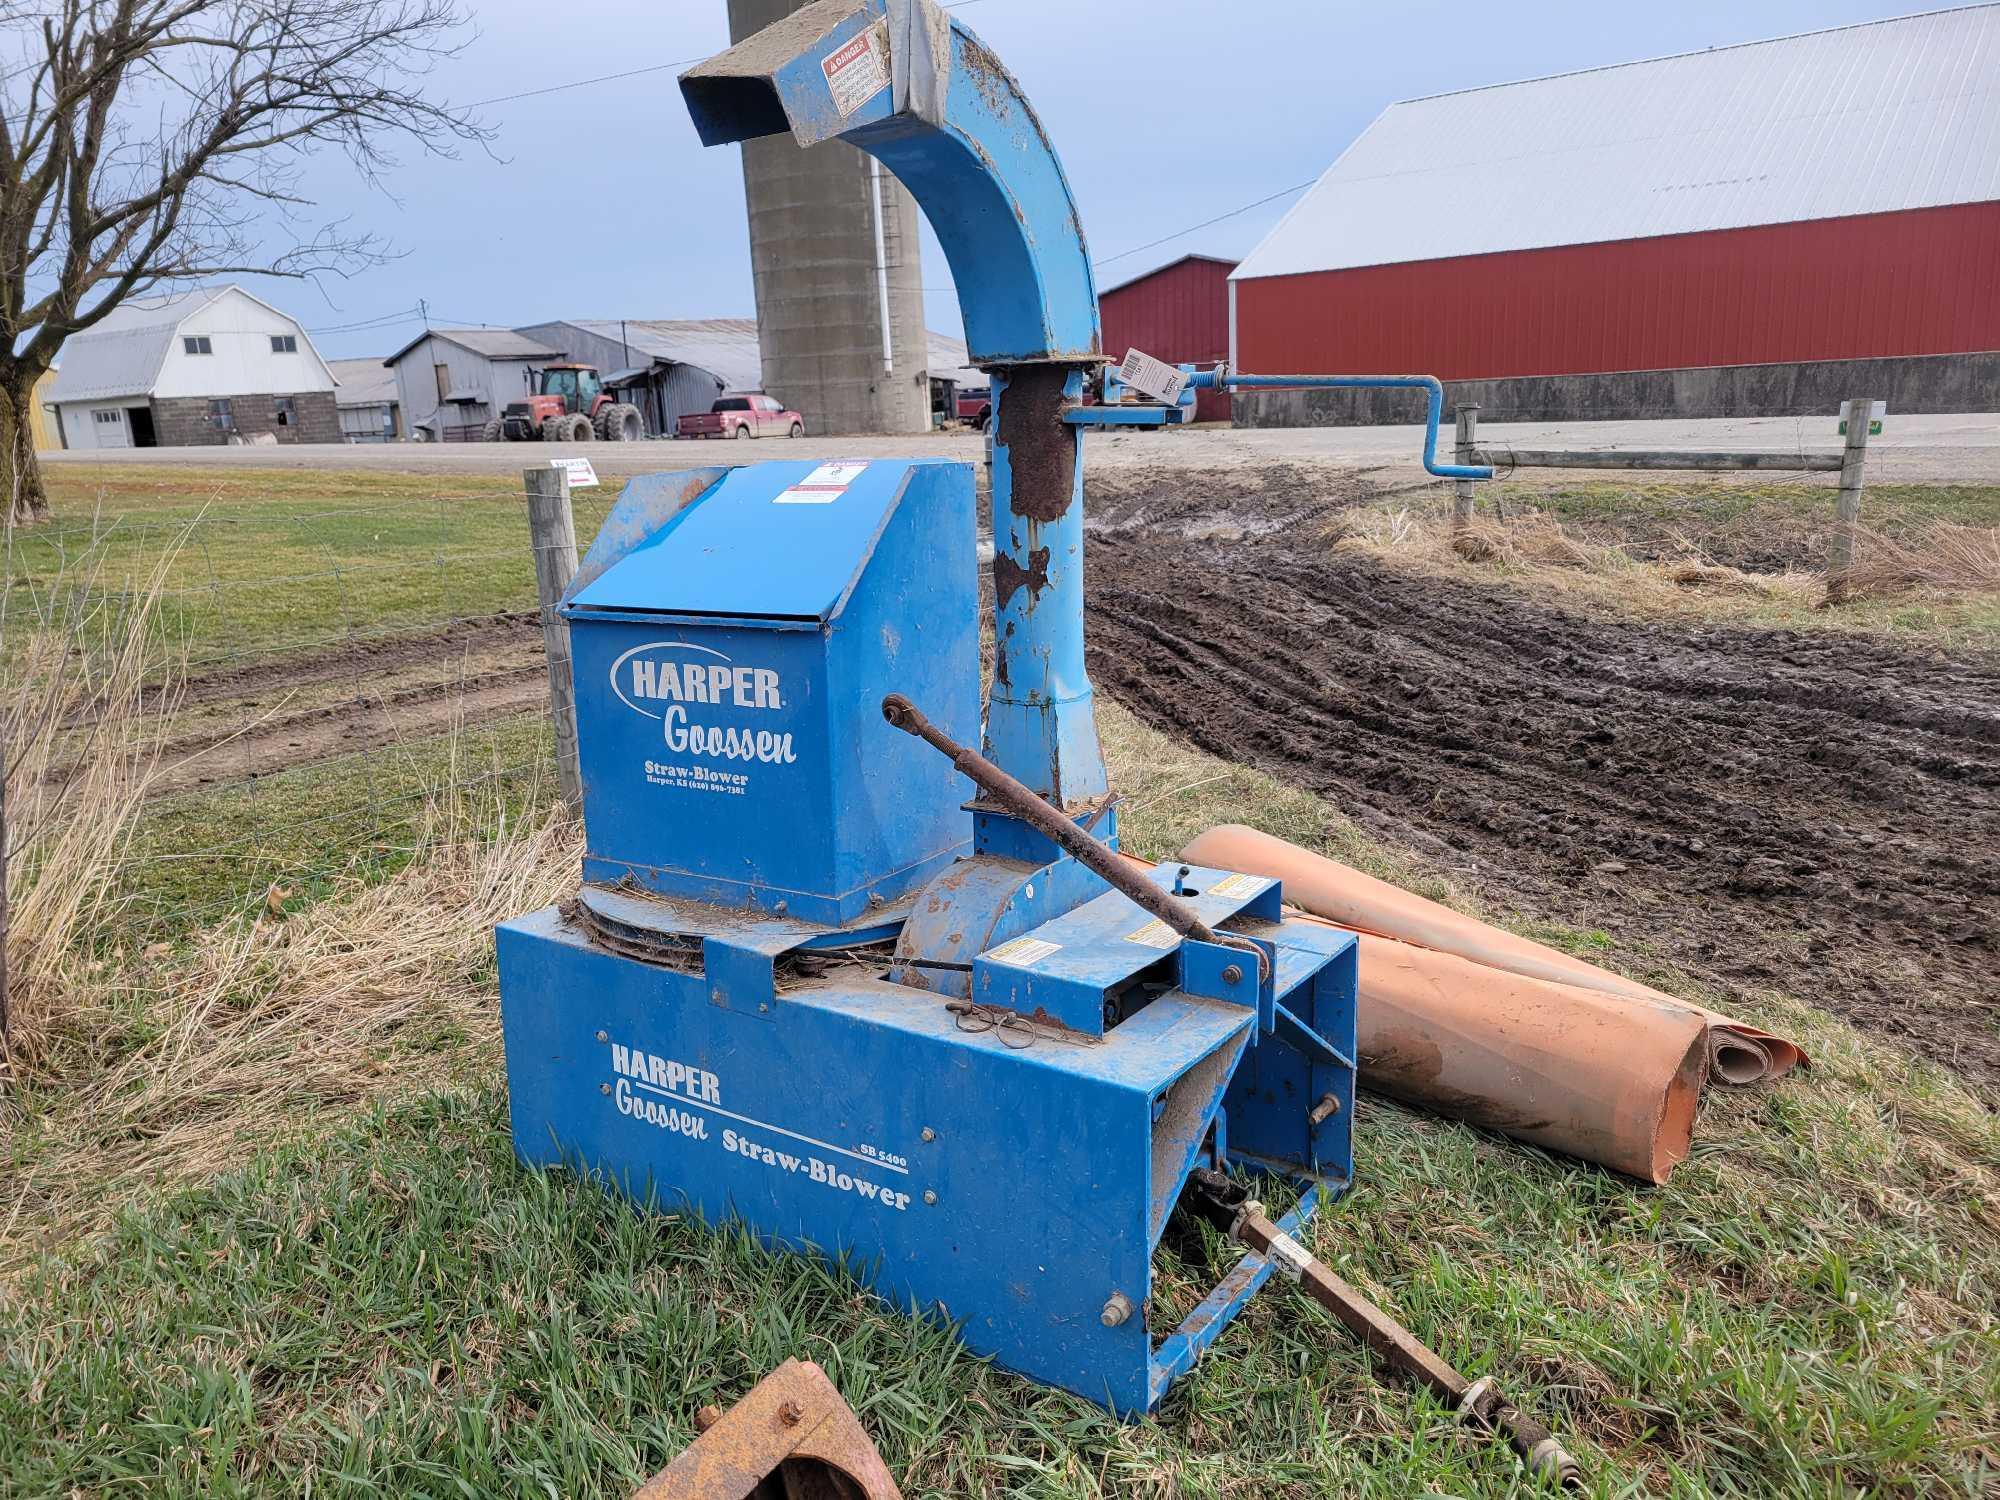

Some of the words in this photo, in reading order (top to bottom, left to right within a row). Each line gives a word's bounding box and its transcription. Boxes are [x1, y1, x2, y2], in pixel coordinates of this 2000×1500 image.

[835, 39, 866, 67] DANGER
[632, 660, 782, 710] HARPER
[664, 704, 797, 764] Goossen
[644, 760, 749, 786] Straw-Blower
[646, 774, 676, 787] Harper,
[676, 778, 688, 788] KS
[688, 780, 709, 791] (620)
[611, 1042, 721, 1106] HARPER
[615, 1077, 709, 1141] Goossen
[722, 1129, 911, 1211] Straw-Blower
[860, 1143, 877, 1157] SB
